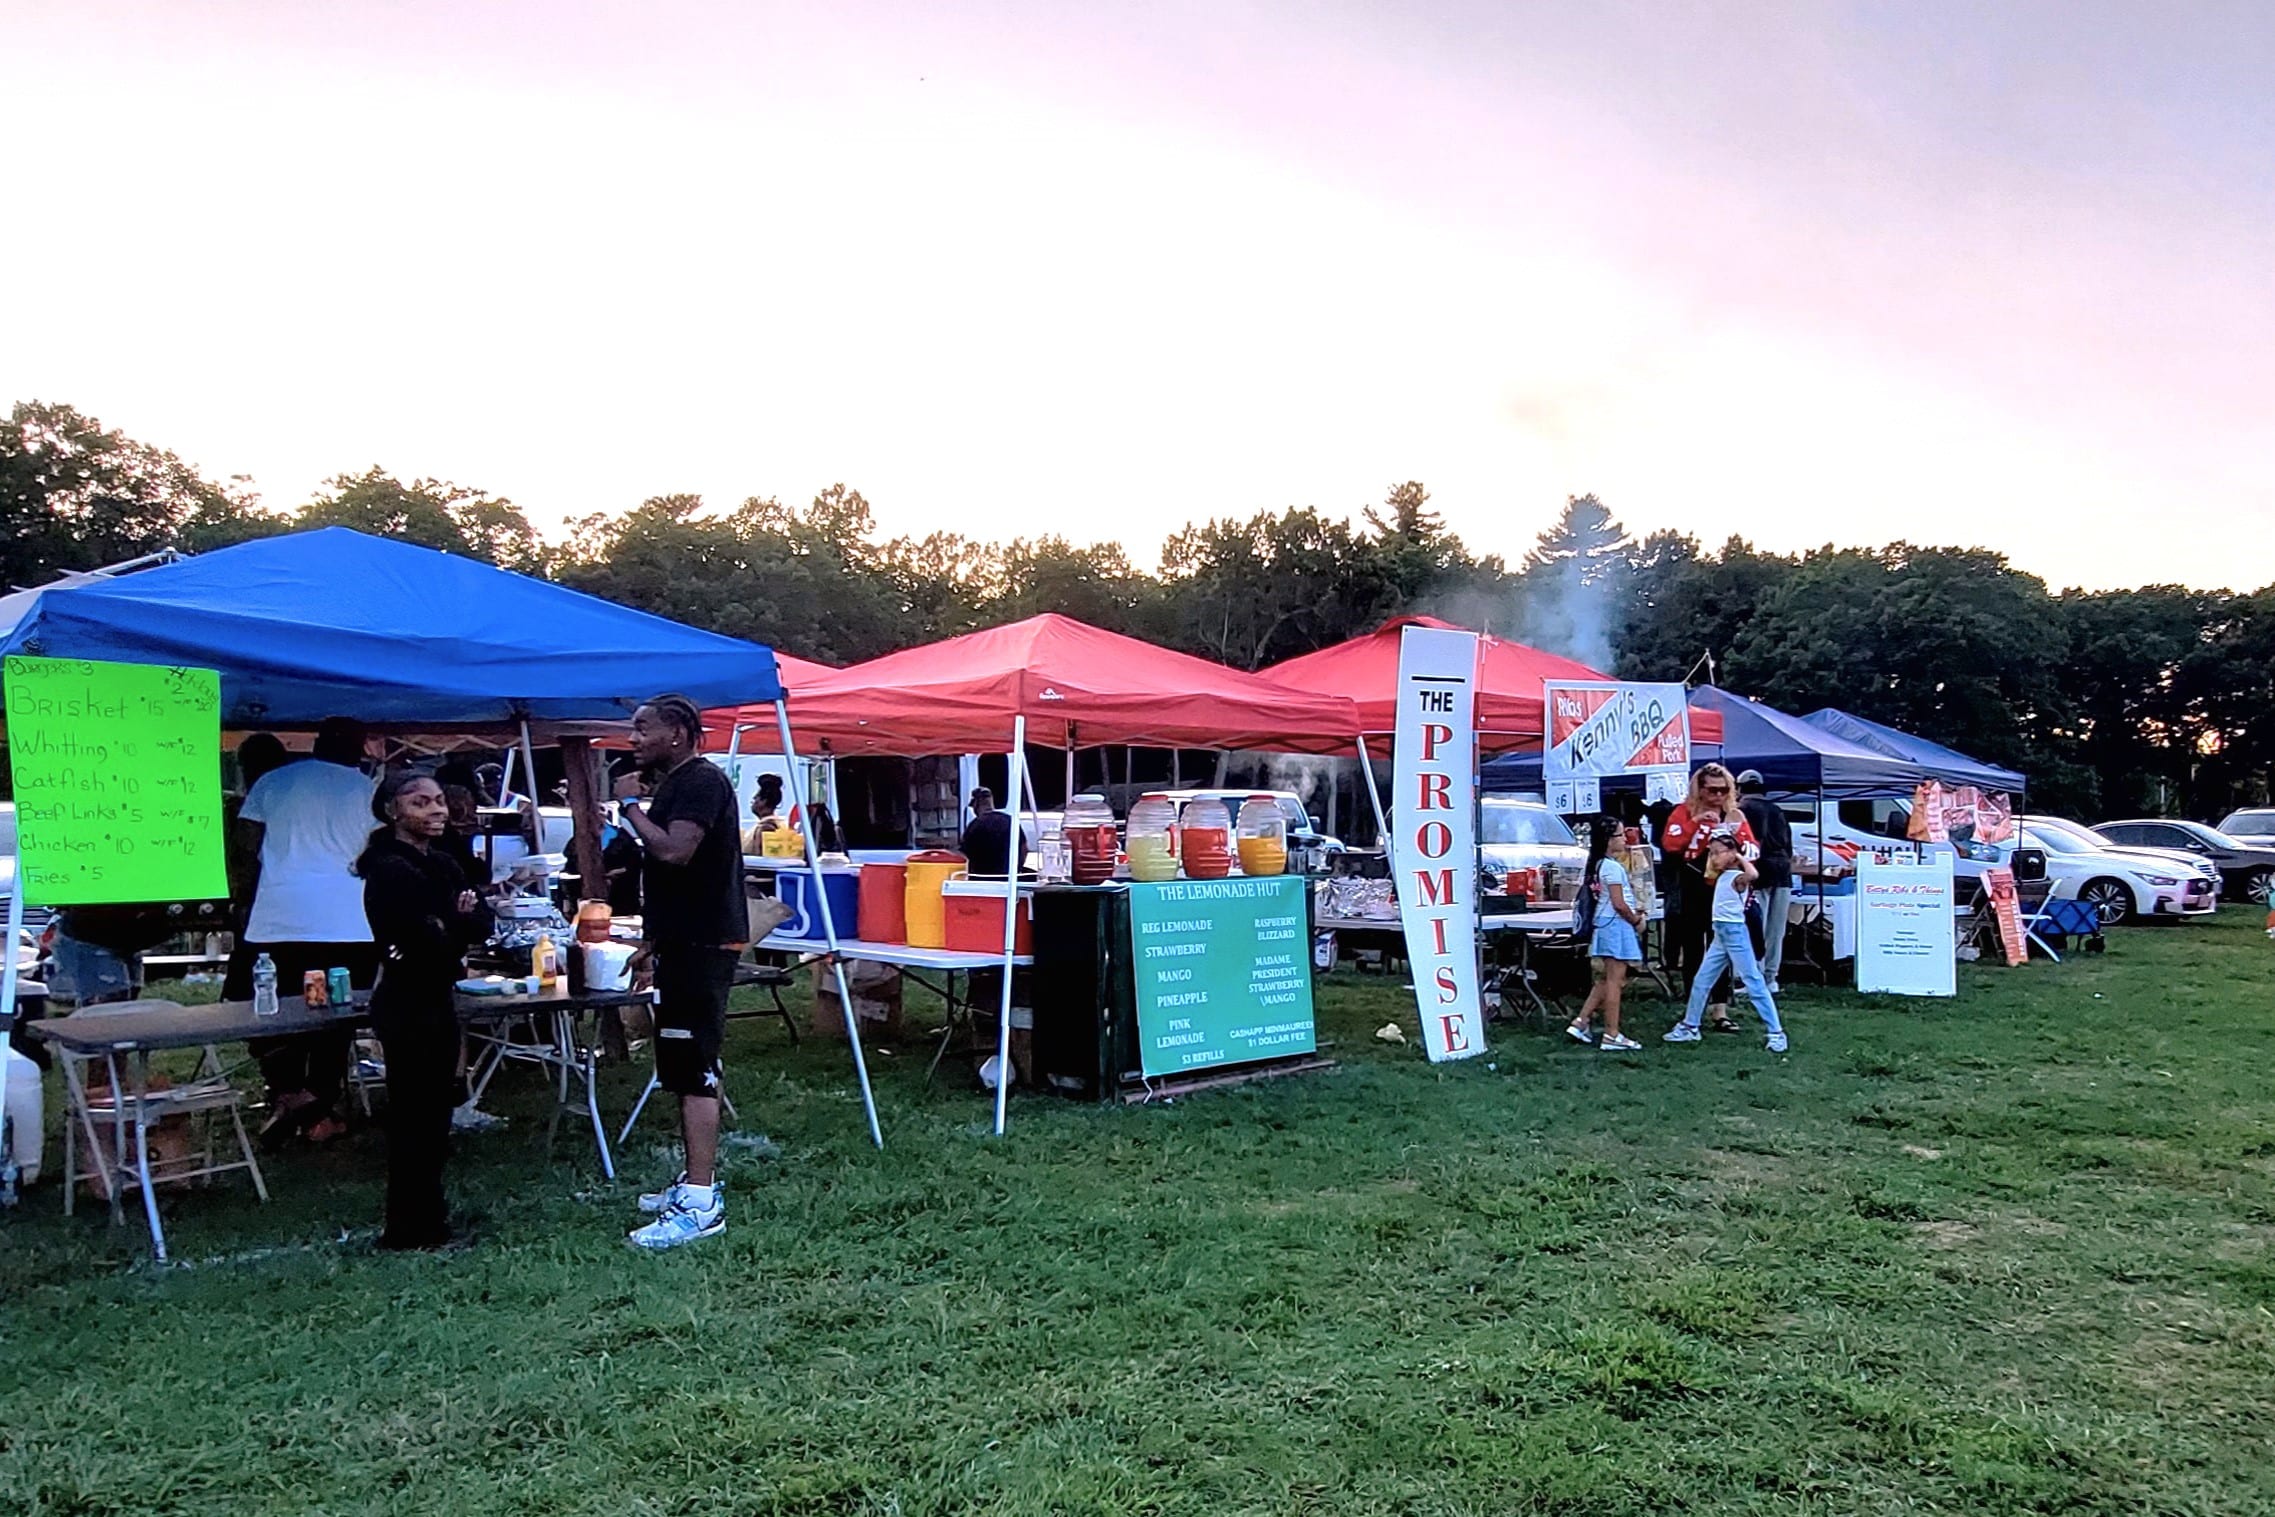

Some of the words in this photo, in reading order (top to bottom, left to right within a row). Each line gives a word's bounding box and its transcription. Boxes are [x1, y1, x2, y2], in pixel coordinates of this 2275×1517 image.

[1419, 690, 1454, 712] THE
[1557, 696, 1583, 718] Ribs
[1570, 690, 1635, 770] Kenny's
[1630, 699, 1665, 750] BBQ
[1662, 748, 1682, 762] Pork
[14, 766, 105, 793] Catfish
[18, 801, 66, 825] Beef
[20, 833, 96, 853] Chicken
[1156, 885, 1185, 901] THE
[1187, 882, 1255, 900] LEMONADE
[1256, 882, 1281, 897] HUT
[1412, 723, 1470, 1054] PROMISE
[1142, 922, 1160, 934] REG
[1162, 919, 1213, 933] LEMONADE
[1144, 943, 1207, 958] STRAWBERRY
[1255, 954, 1292, 967] MADAME
[1157, 969, 1192, 983] MANGO
[1252, 966, 1298, 980] PRESIDENT
[1248, 979, 1305, 993] STRAWBERRY
[1157, 991, 1208, 1008] PINEAPPLE
[1168, 1018, 1191, 1031] PINK
[1156, 1031, 1206, 1049] LEMONADE
[1258, 1033, 1290, 1046] DOLLAR
[1192, 1049, 1225, 1063] REFILLS
